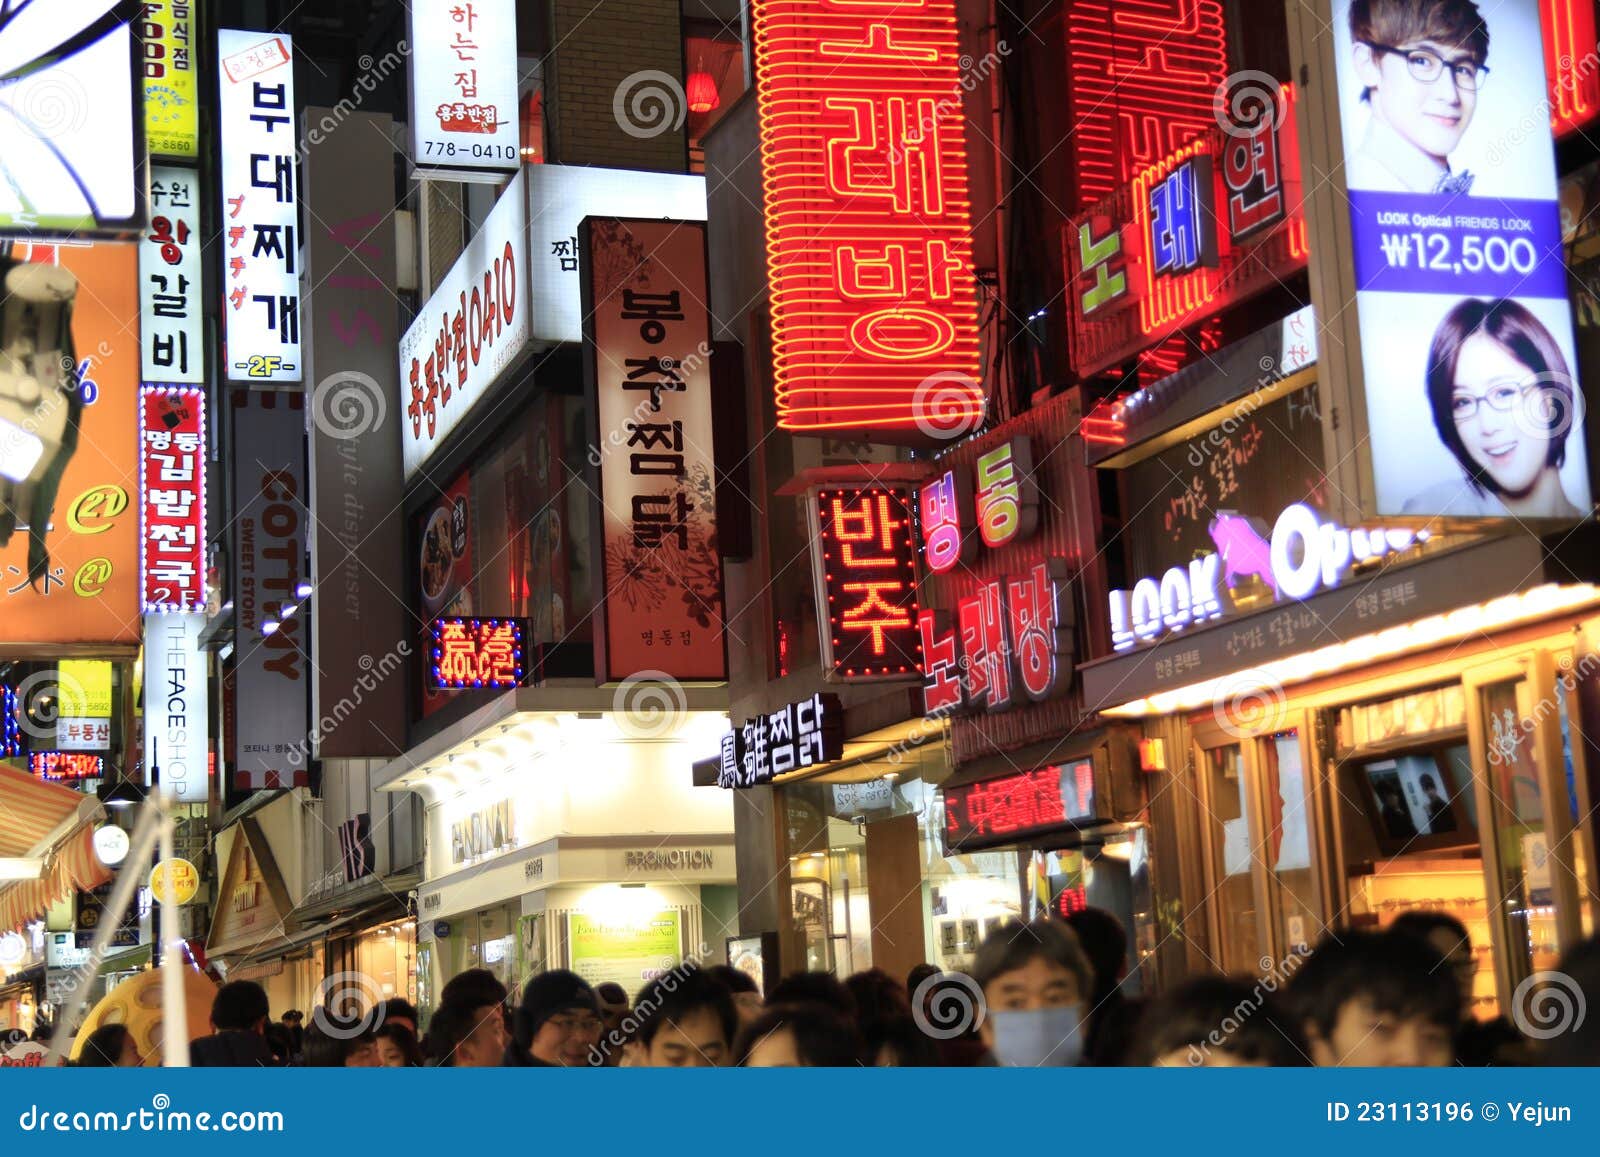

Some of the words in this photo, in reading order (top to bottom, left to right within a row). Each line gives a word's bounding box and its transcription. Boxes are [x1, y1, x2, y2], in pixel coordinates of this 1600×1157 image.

[437, 104, 496, 124] 홍콩반점
[425, 141, 515, 160] 778-0410
[150, 182, 190, 208] 수원
[250, 82, 299, 344] 부대찌개
[1377, 211, 1411, 226] LOOK
[1412, 212, 1451, 229] Optical
[1455, 215, 1499, 230] FRIENDS
[1502, 217, 1533, 232] LOOK
[620, 288, 694, 551] 봉추찜닭
[146, 430, 201, 452] 명동
[147, 453, 197, 588] 김밥천국
[241, 517, 255, 572] SWEET
[832, 494, 911, 656] 반주
[241, 576, 255, 631] STORY
[1109, 552, 1223, 648] LOOK
[640, 630, 692, 647] 명동점
[918, 562, 1055, 716] 노래방
[68, 722, 110, 742] 부동산
[624, 847, 714, 869] PROMOTION
